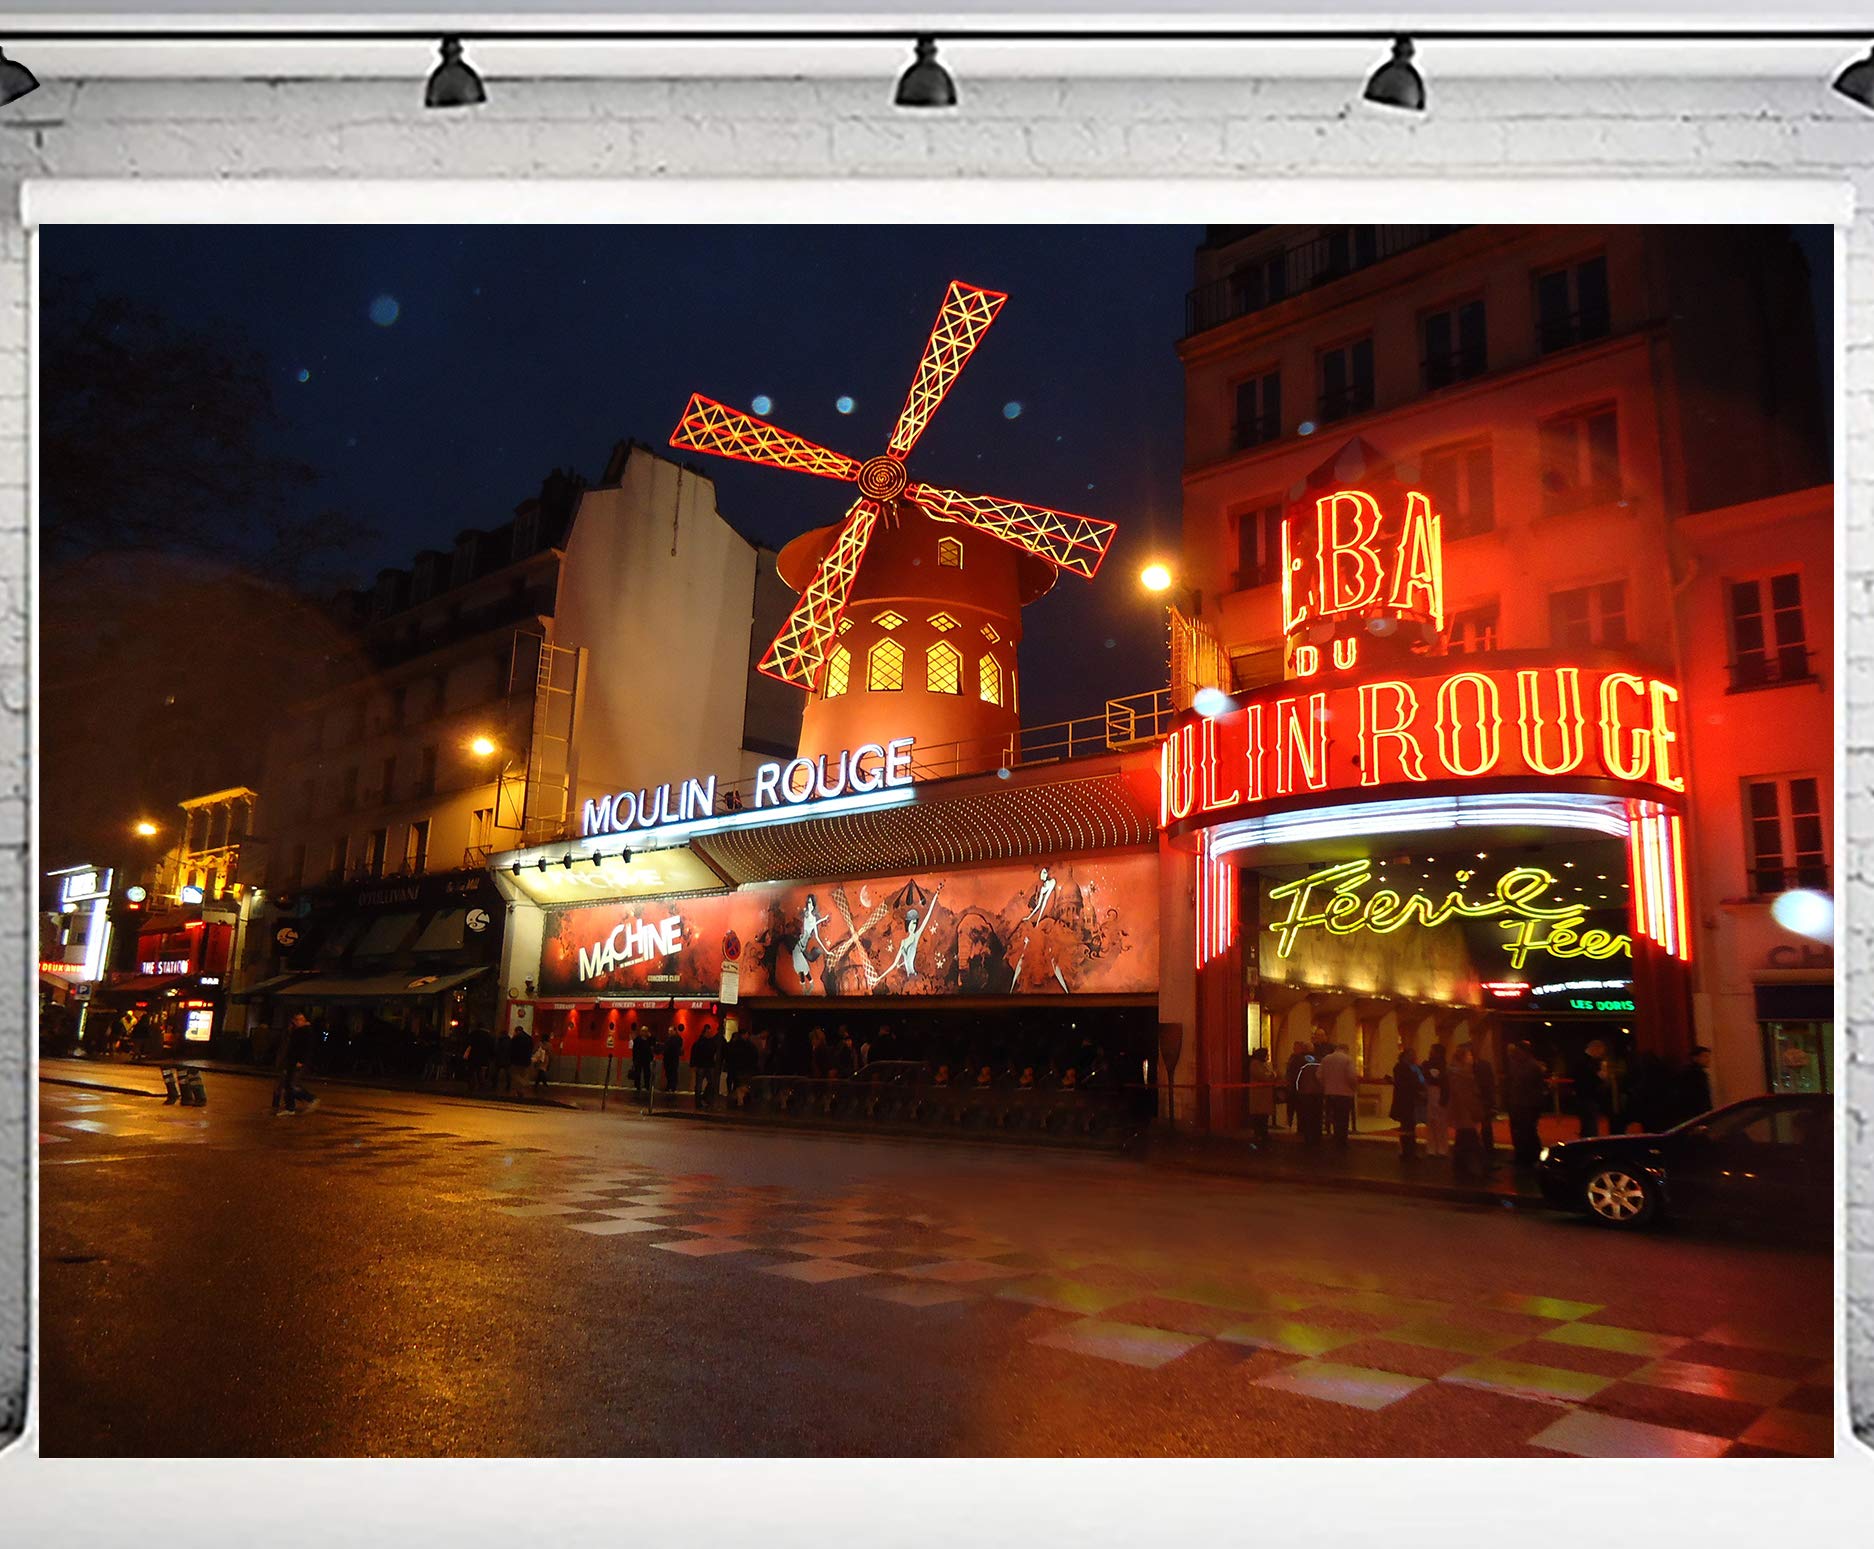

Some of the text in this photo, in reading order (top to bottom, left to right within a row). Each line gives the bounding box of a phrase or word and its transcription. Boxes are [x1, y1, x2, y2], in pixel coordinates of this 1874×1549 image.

[1296, 638, 1356, 676] DU
[1160, 668, 1685, 827] ULIN ROUGE
[583, 737, 915, 836] MOULIN ROUGE
[142, 961, 155, 974] THE
[579, 915, 682, 982] MACHINE
[691, 1001, 703, 1009] BAR
